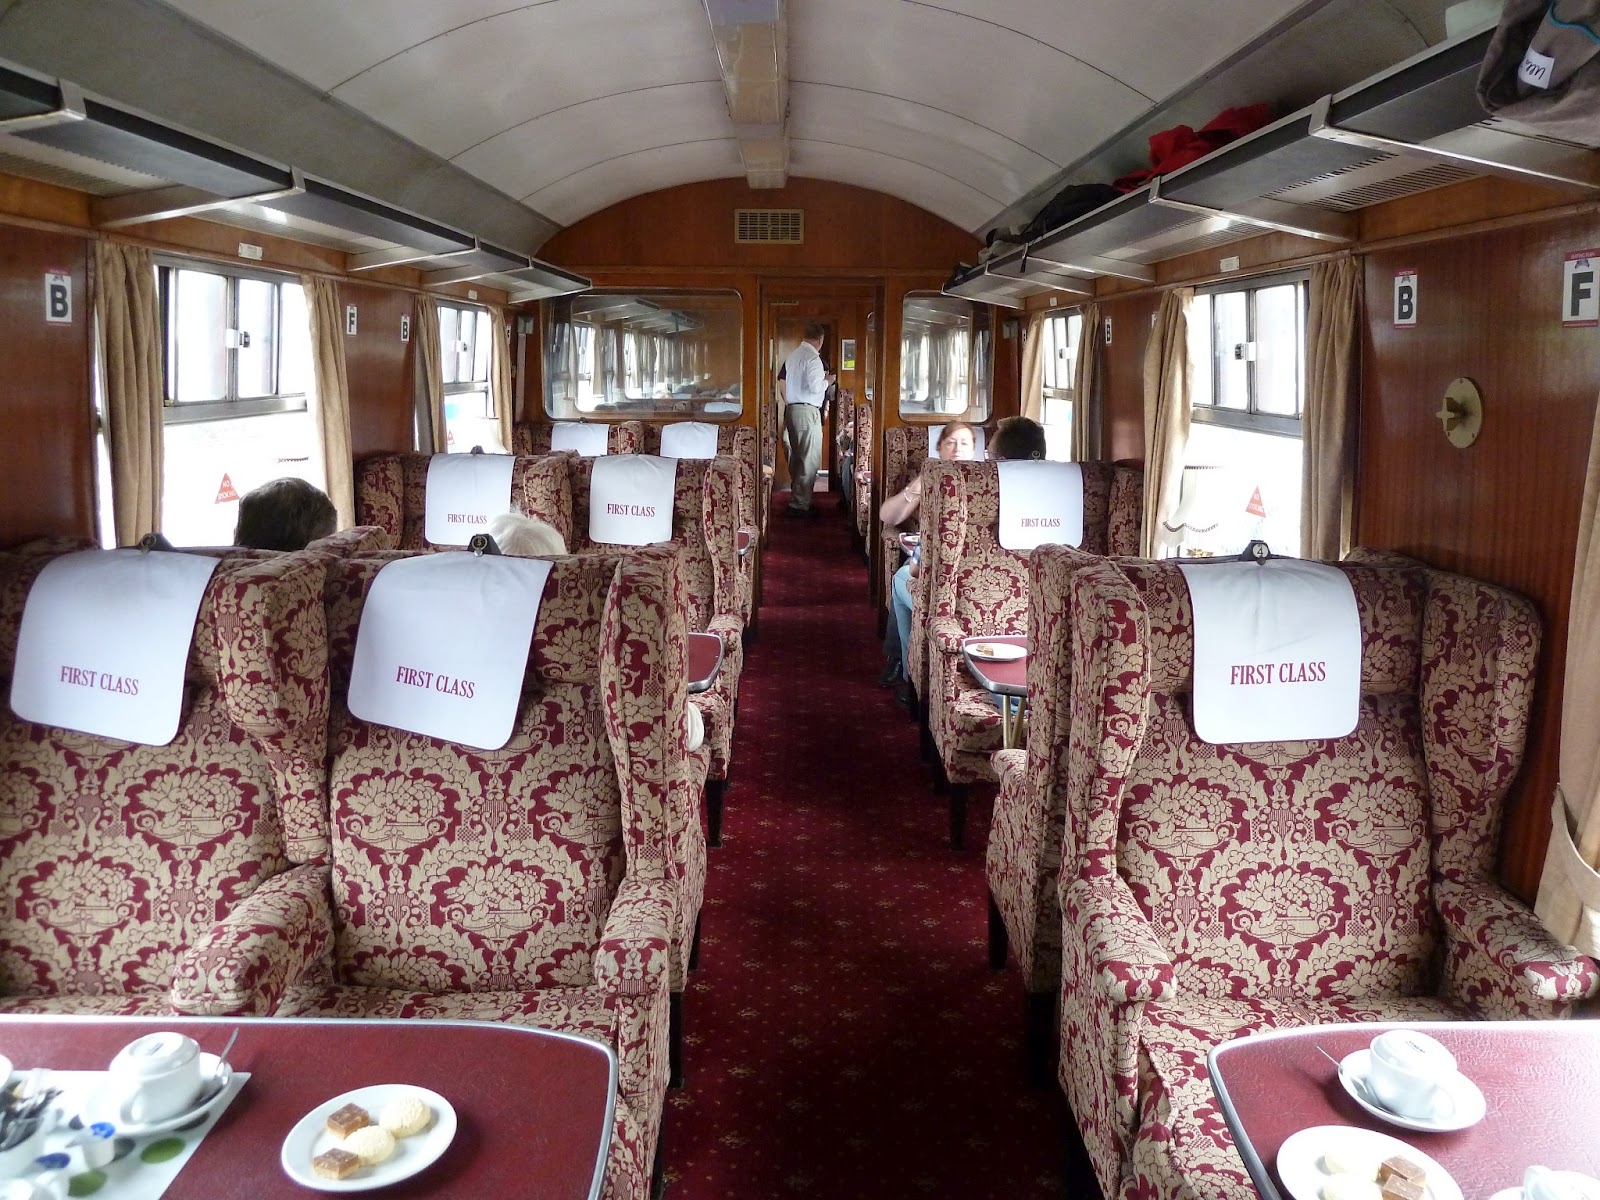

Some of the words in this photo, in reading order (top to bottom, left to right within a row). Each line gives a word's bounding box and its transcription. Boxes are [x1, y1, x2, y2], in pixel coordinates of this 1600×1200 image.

[51, 284, 69, 318] B
[1398, 285, 1413, 320] B
[1571, 271, 1594, 317] F
[349, 312, 356, 333] F
[402, 321, 408, 340] B
[447, 513, 466, 523] FIRST
[467, 514, 488, 524] CLASS
[607, 503, 630, 516] FIRST
[631, 505, 656, 518] CLASS
[1021, 518, 1039, 528] FIRST
[1040, 518, 1061, 528] CLASS
[60, 665, 98, 688] FIRST
[100, 673, 139, 696] CLASS
[396, 665, 434, 689] FIRST
[435, 674, 475, 699] CLASS
[1230, 663, 1275, 685] FIRST
[1278, 661, 1326, 683] CLASS
